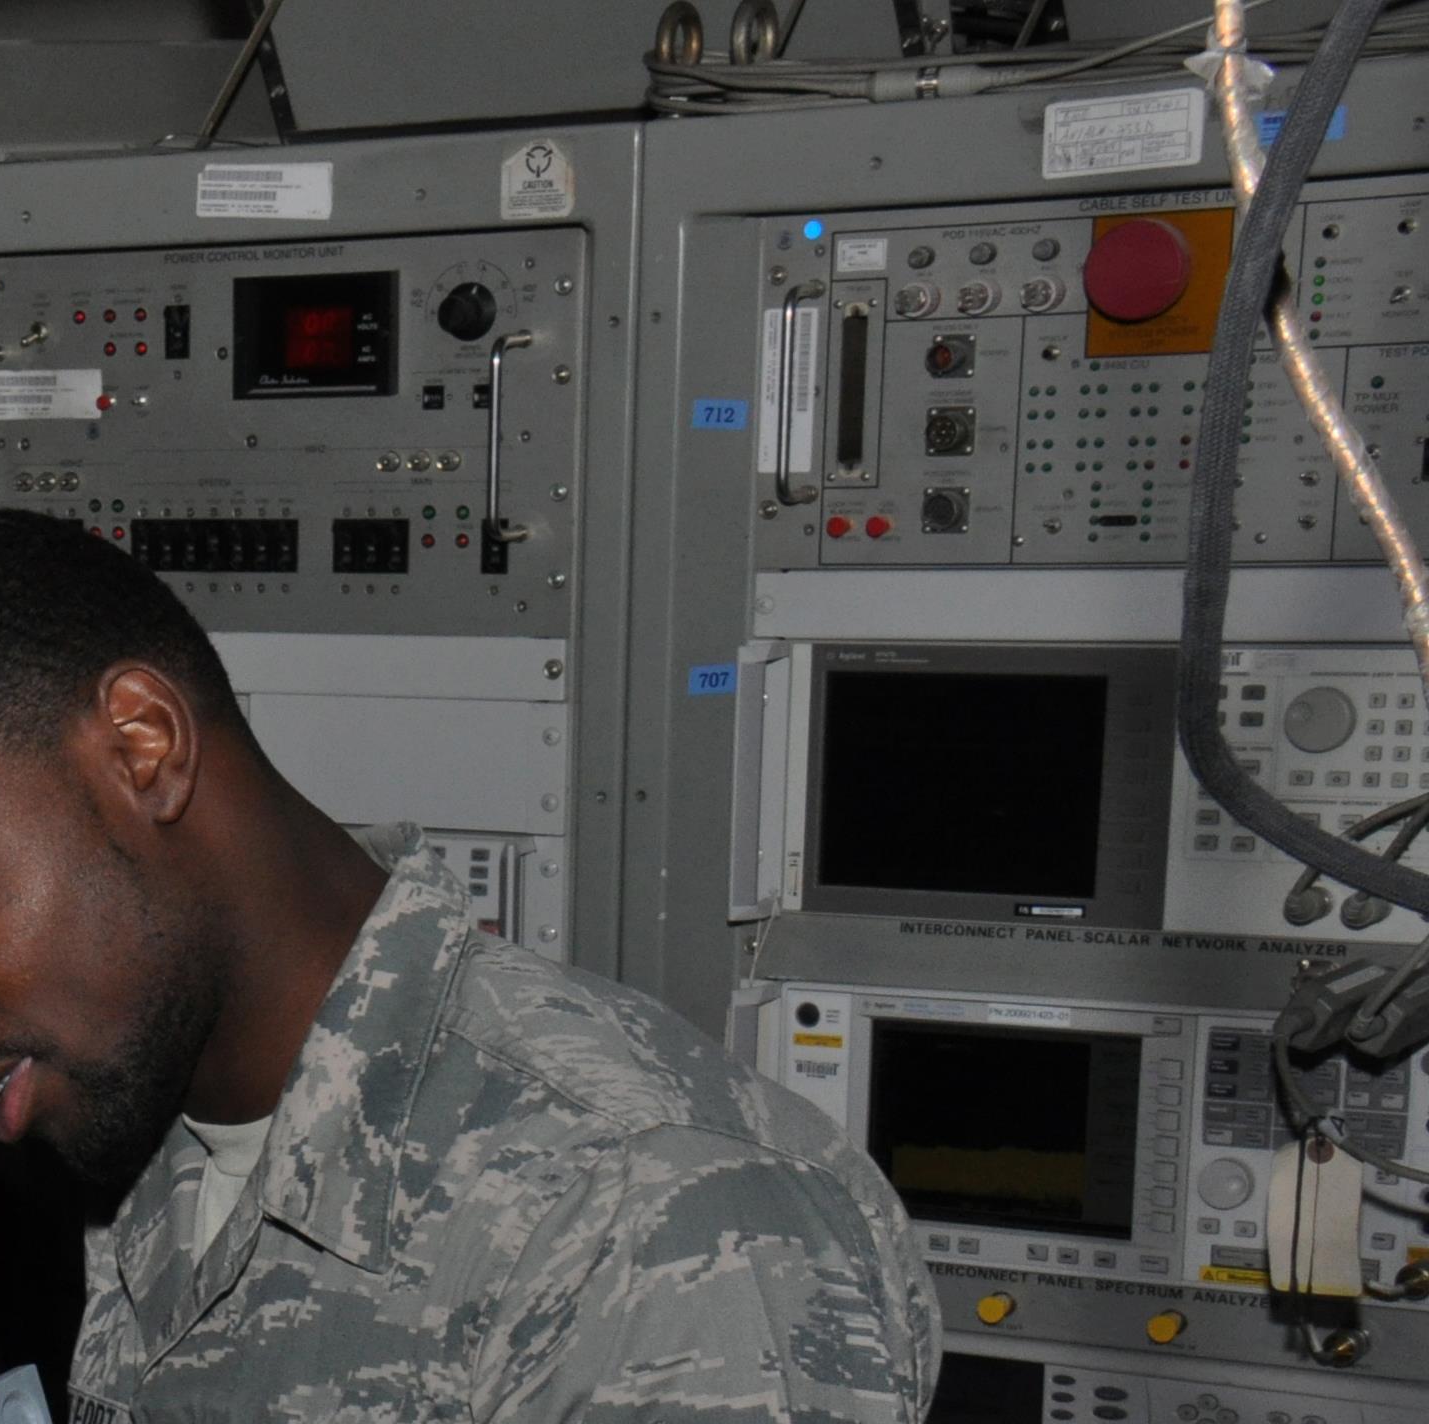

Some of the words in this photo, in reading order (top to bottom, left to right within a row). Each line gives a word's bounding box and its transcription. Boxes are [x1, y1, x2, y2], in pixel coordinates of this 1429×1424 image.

[522, 180, 554, 190] CAUTION
[1079, 199, 1128, 213] CABLE
[1131, 196, 1168, 210] SELF
[1172, 193, 1211, 207] TEST
[943, 229, 966, 240] POD
[164, 253, 205, 265] POWER
[207, 251, 260, 263] CONTROL
[263, 249, 315, 261] MONITOR
[318, 247, 345, 258] UNIT
[704, 406, 736, 424] 712
[698, 671, 730, 689] 707
[899, 921, 1017, 941] INTERCONNECT
[1161, 935, 1248, 953] NETWORK
[1258, 940, 1348, 958] ANALYZER
[926, 1261, 1028, 1285] TERCONNECT
